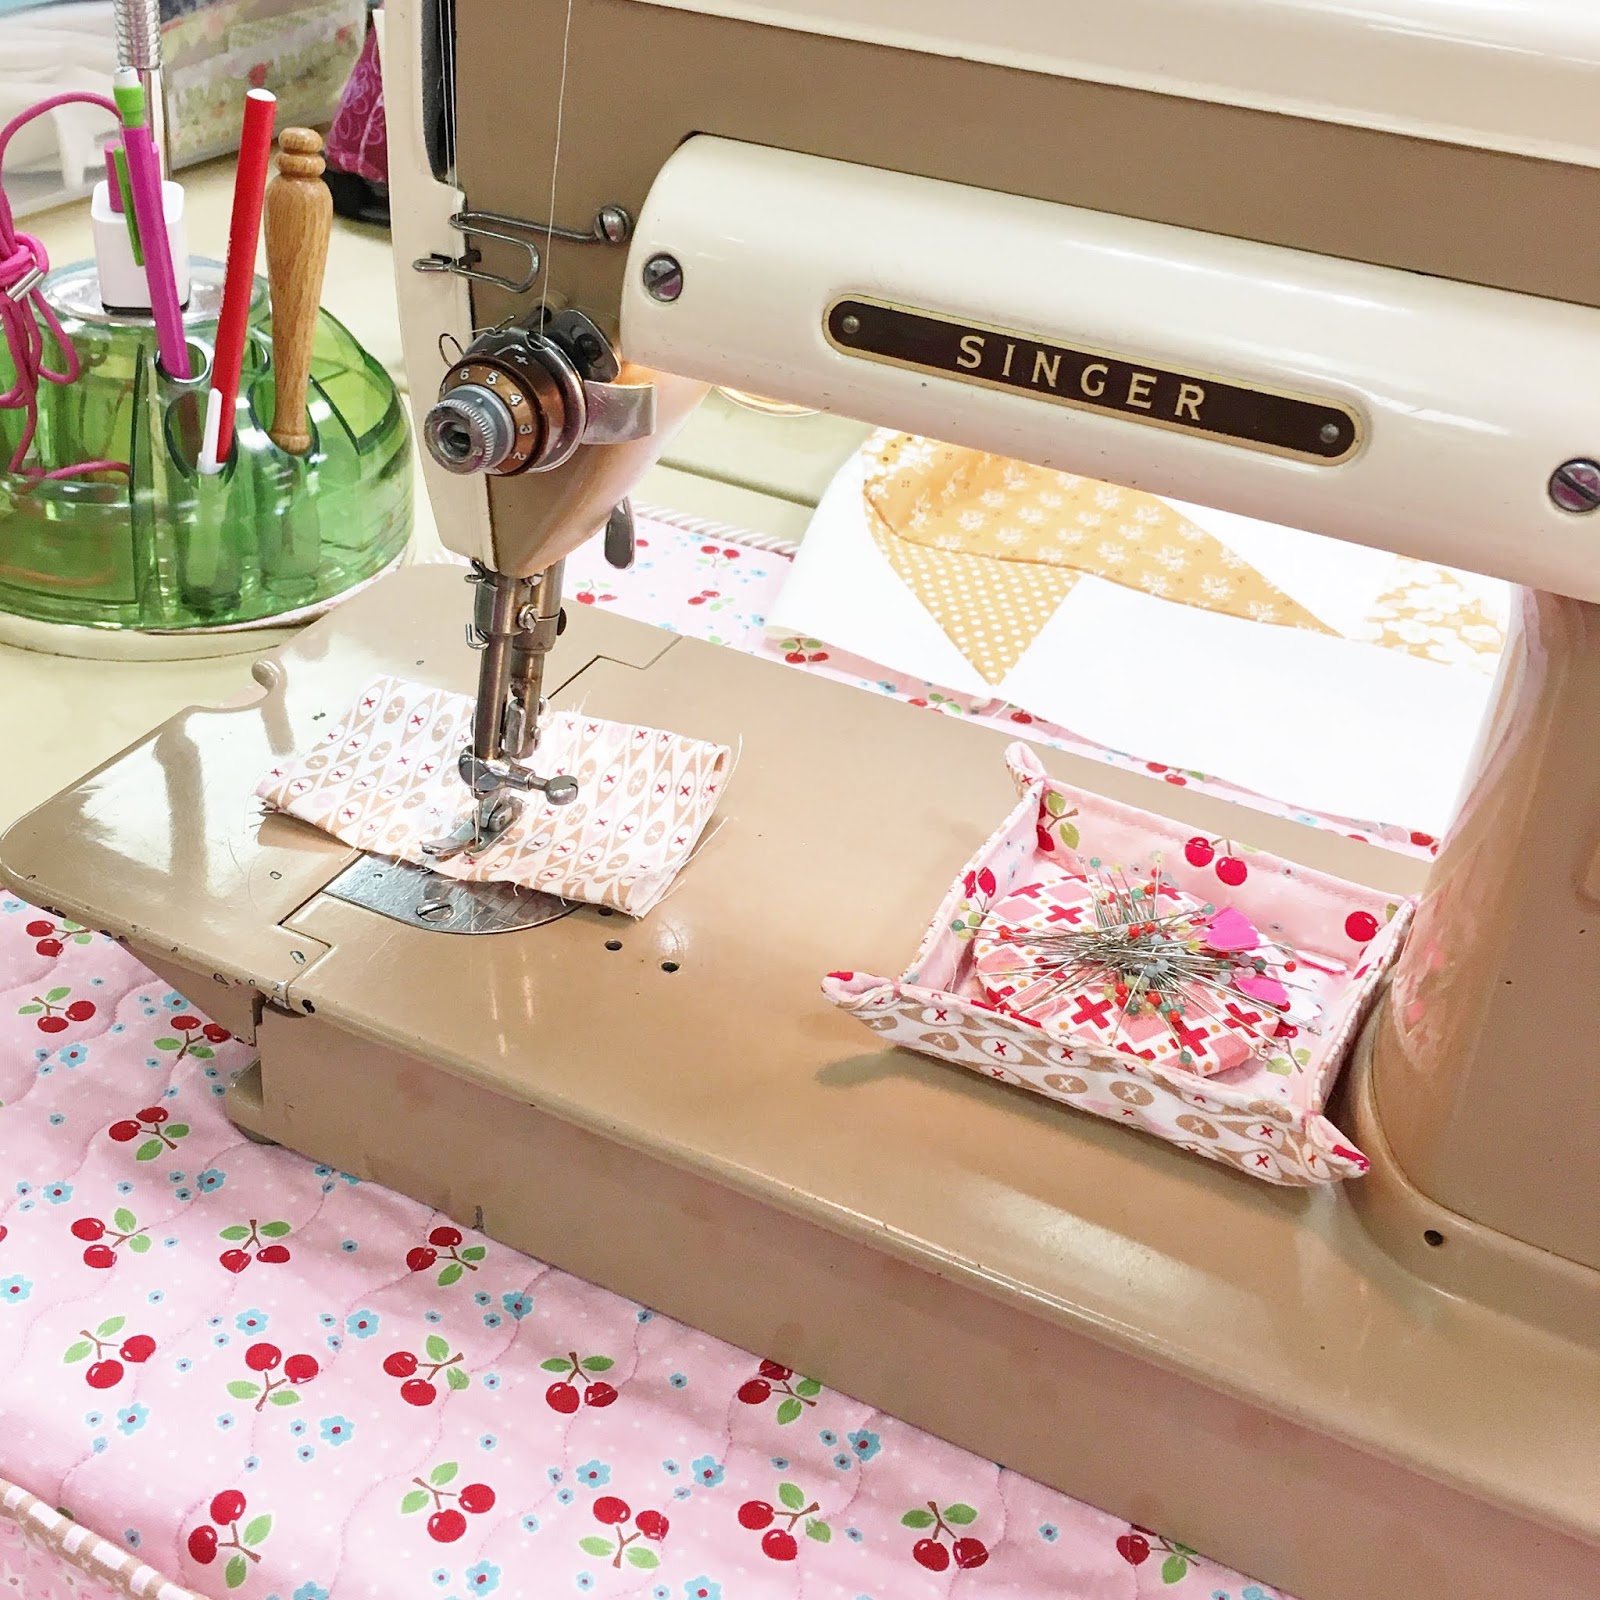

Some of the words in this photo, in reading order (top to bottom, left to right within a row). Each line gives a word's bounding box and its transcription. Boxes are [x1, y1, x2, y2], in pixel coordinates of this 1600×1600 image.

[460, 368, 470, 380] 6
[485, 371, 498, 385] 5
[956, 334, 1206, 421] SINGER
[509, 393, 523, 406] 4
[519, 424, 533, 436] 3
[512, 451, 527, 461] 2
